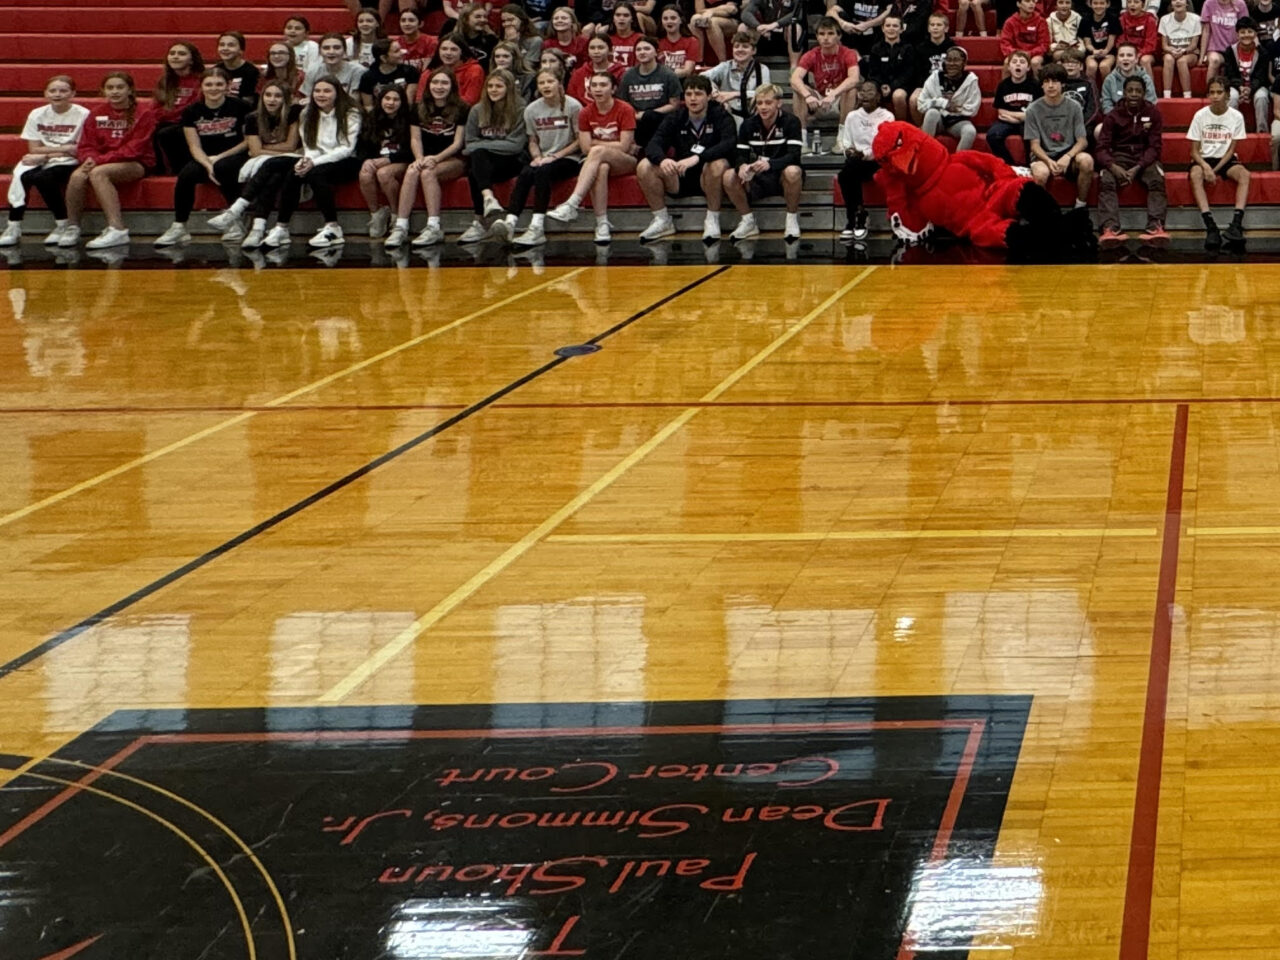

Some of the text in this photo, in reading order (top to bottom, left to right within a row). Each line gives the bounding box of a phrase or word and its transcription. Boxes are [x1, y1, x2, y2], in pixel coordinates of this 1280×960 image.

[434, 756, 839, 792] Center Court
[322, 798, 892, 845] Dean Simmons, Jr.
[378, 852, 758, 896] Paul Shoun
